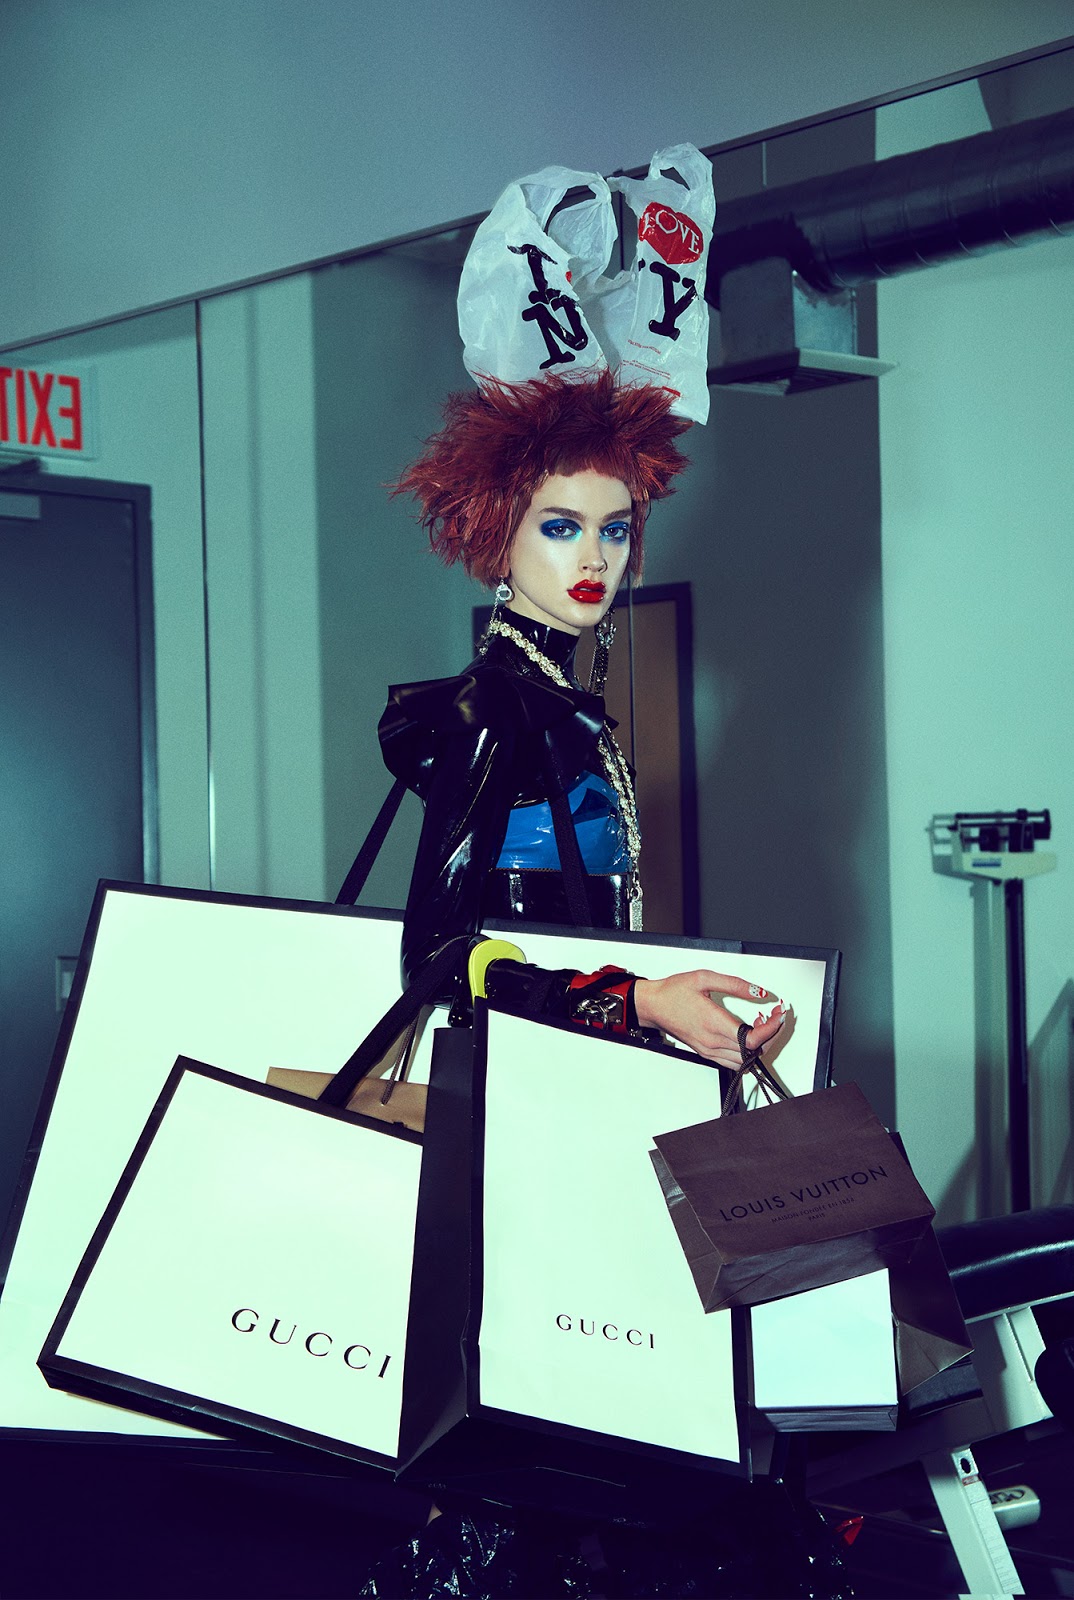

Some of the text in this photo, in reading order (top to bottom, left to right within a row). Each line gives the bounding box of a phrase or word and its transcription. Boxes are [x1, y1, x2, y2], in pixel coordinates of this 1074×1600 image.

[719, 1165, 888, 1222] LOUIS VUITTON
[771, 1211, 799, 1223] MAISON
[231, 1308, 392, 1379] GUCCI
[555, 1313, 655, 1349] GUCCI
